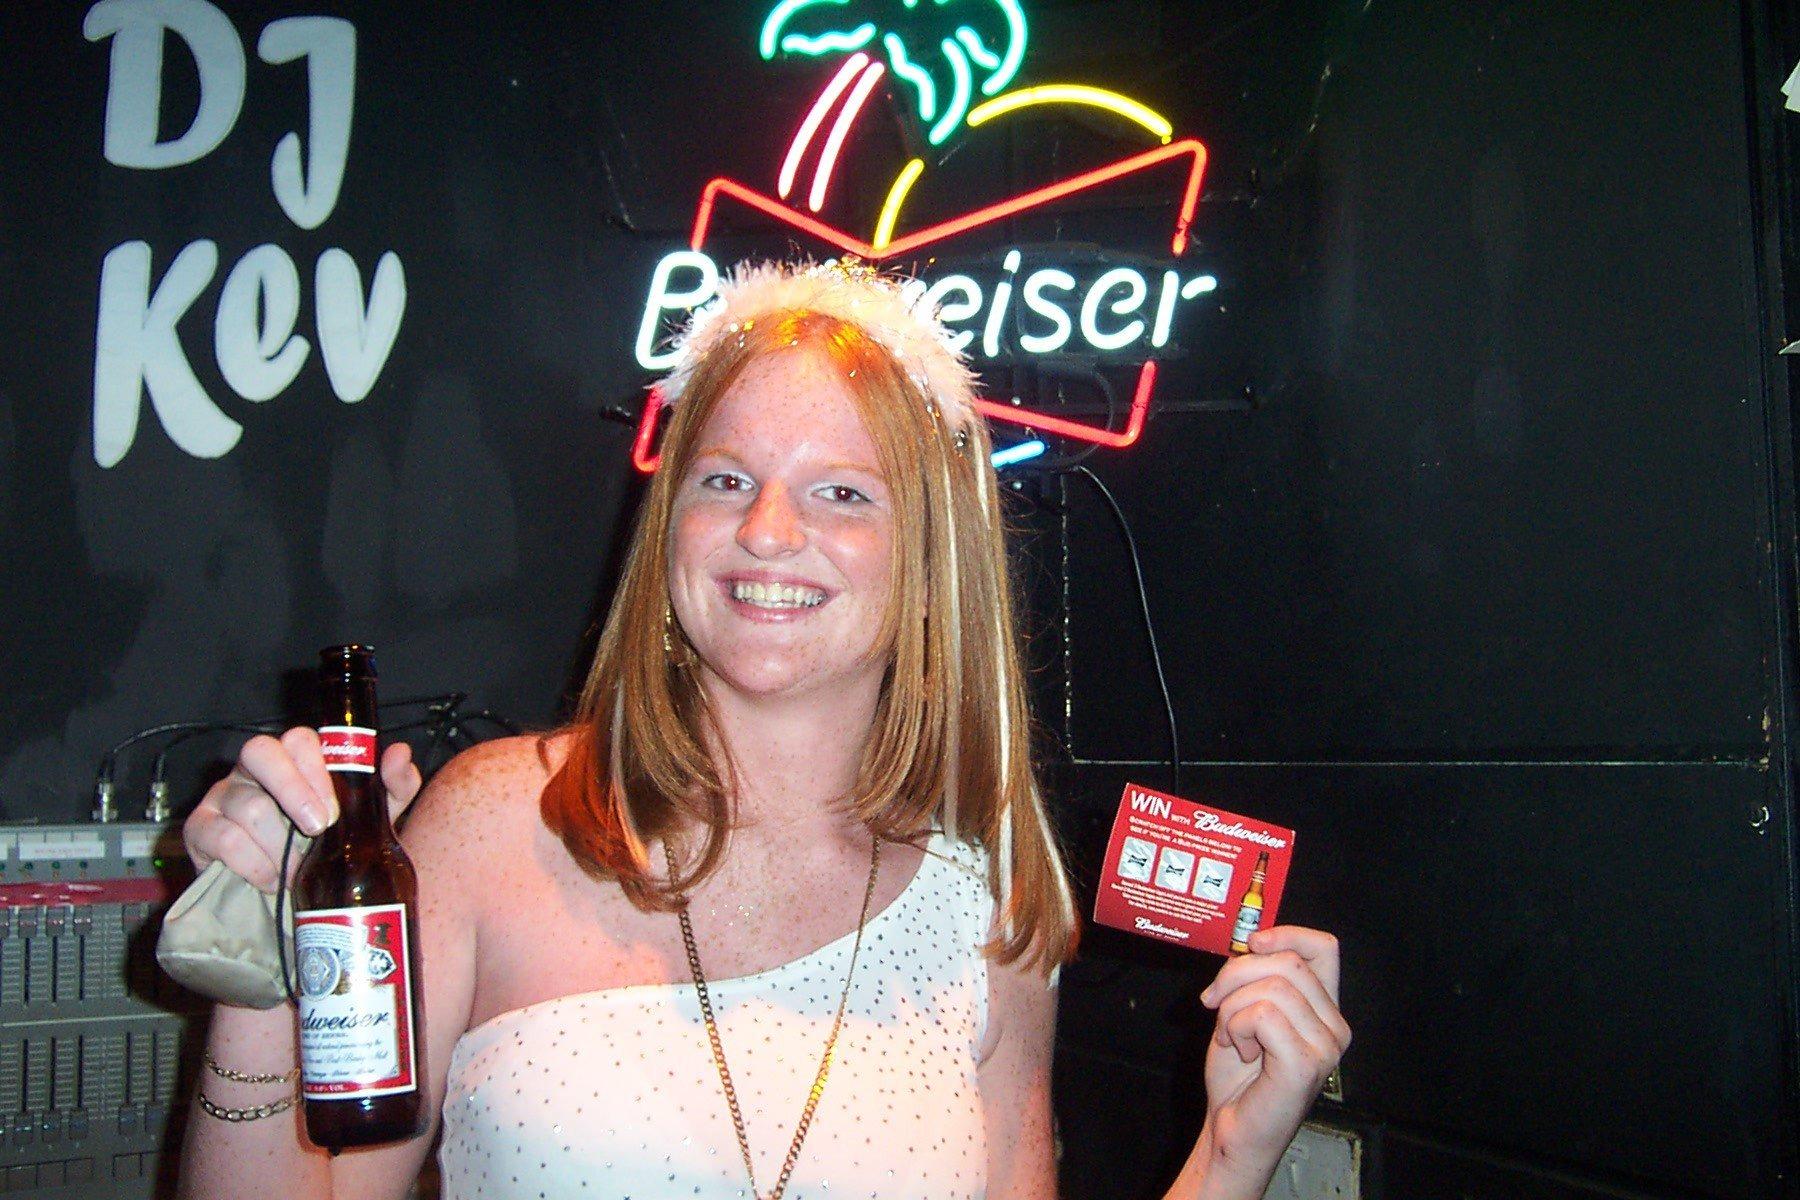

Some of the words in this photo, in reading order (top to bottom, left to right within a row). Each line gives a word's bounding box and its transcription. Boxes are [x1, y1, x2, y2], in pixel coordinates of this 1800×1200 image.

[84, 0, 357, 230] DJ
[93, 238, 407, 469] Kev
[635, 249, 1217, 371] Beiser
[1131, 790, 1172, 820] WIN
[1193, 810, 1286, 849] Budweiser
[1135, 916, 1190, 938] Budweiser
[302, 1007, 389, 1031] dweiser
